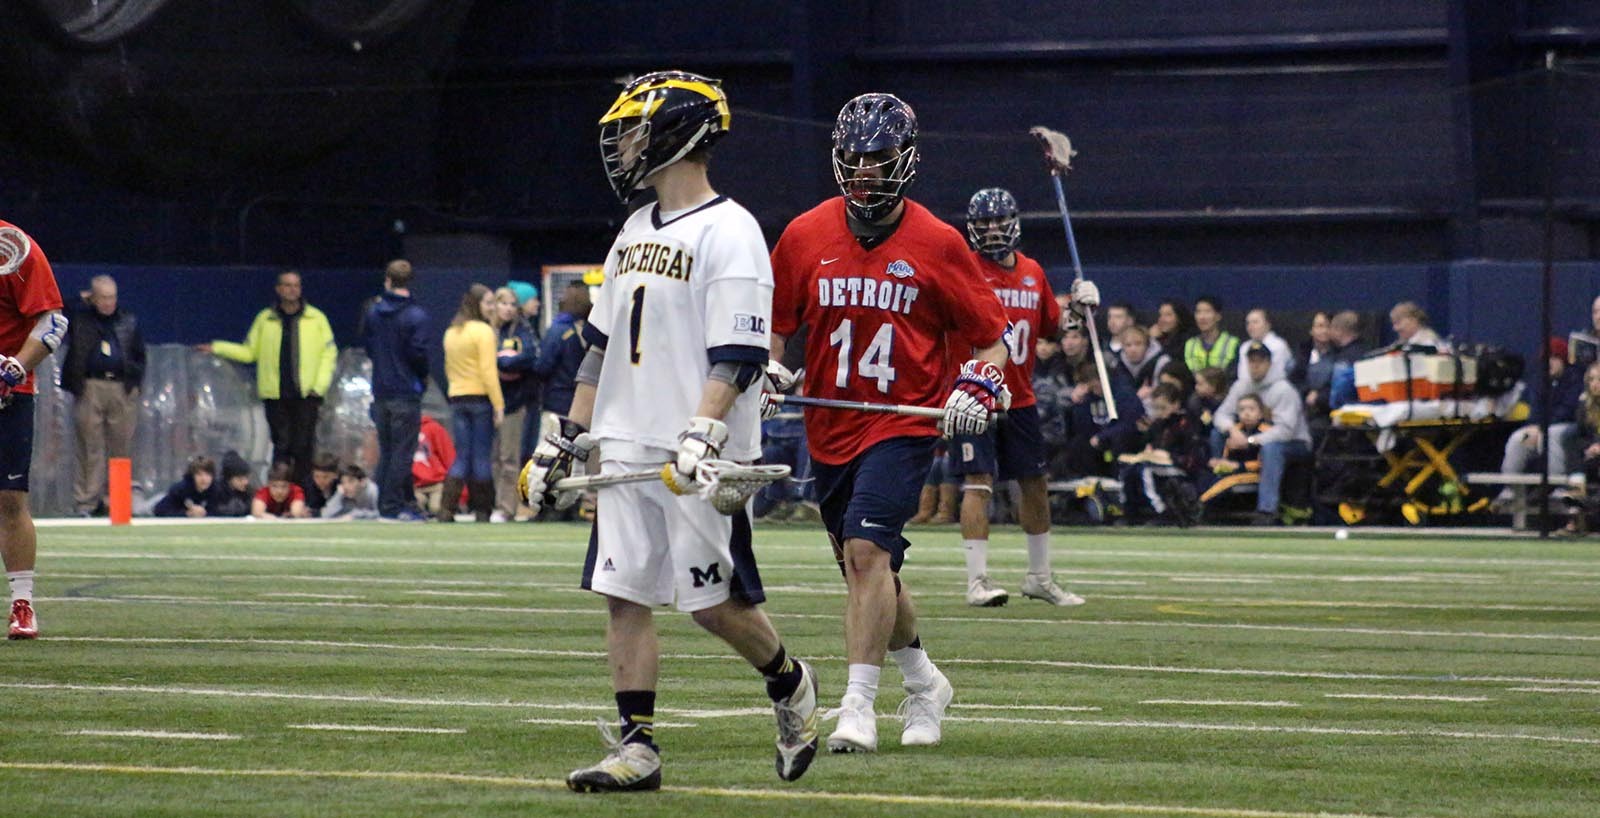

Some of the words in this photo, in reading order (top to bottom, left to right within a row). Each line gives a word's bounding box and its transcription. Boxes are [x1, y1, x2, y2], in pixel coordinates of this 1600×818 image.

[818, 277, 919, 314] DETROIT
[993, 288, 1040, 310] TROIT
[630, 284, 645, 366] 1
[829, 318, 896, 393] 14
[962, 442, 974, 461] D
[689, 562, 722, 588] M
